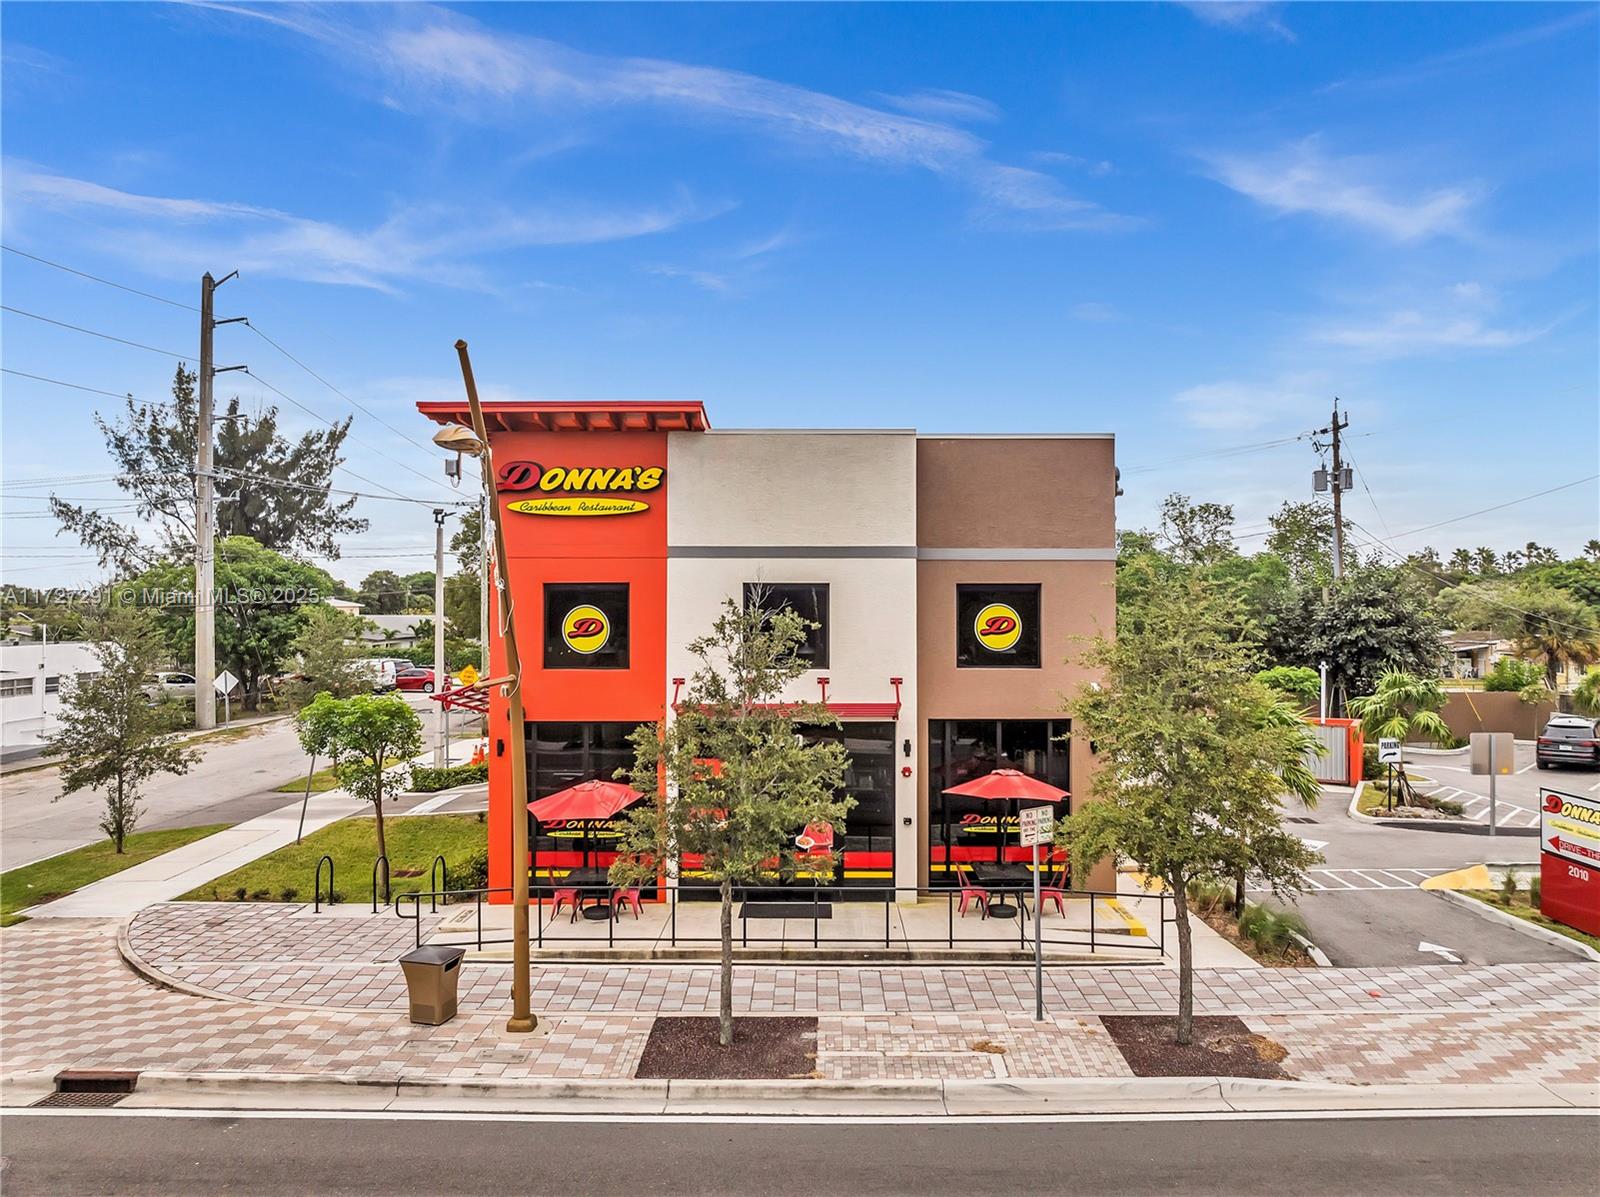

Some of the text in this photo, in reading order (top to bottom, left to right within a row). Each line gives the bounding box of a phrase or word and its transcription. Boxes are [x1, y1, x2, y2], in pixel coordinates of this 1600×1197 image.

[496, 460, 664, 493] DONNA'S
[519, 502, 636, 512] Caribbean Restaurant
[568, 617, 604, 638] D
[980, 616, 1016, 636] D
[1380, 741, 1400, 749] PARKING
[1568, 865, 1589, 881] 2010
